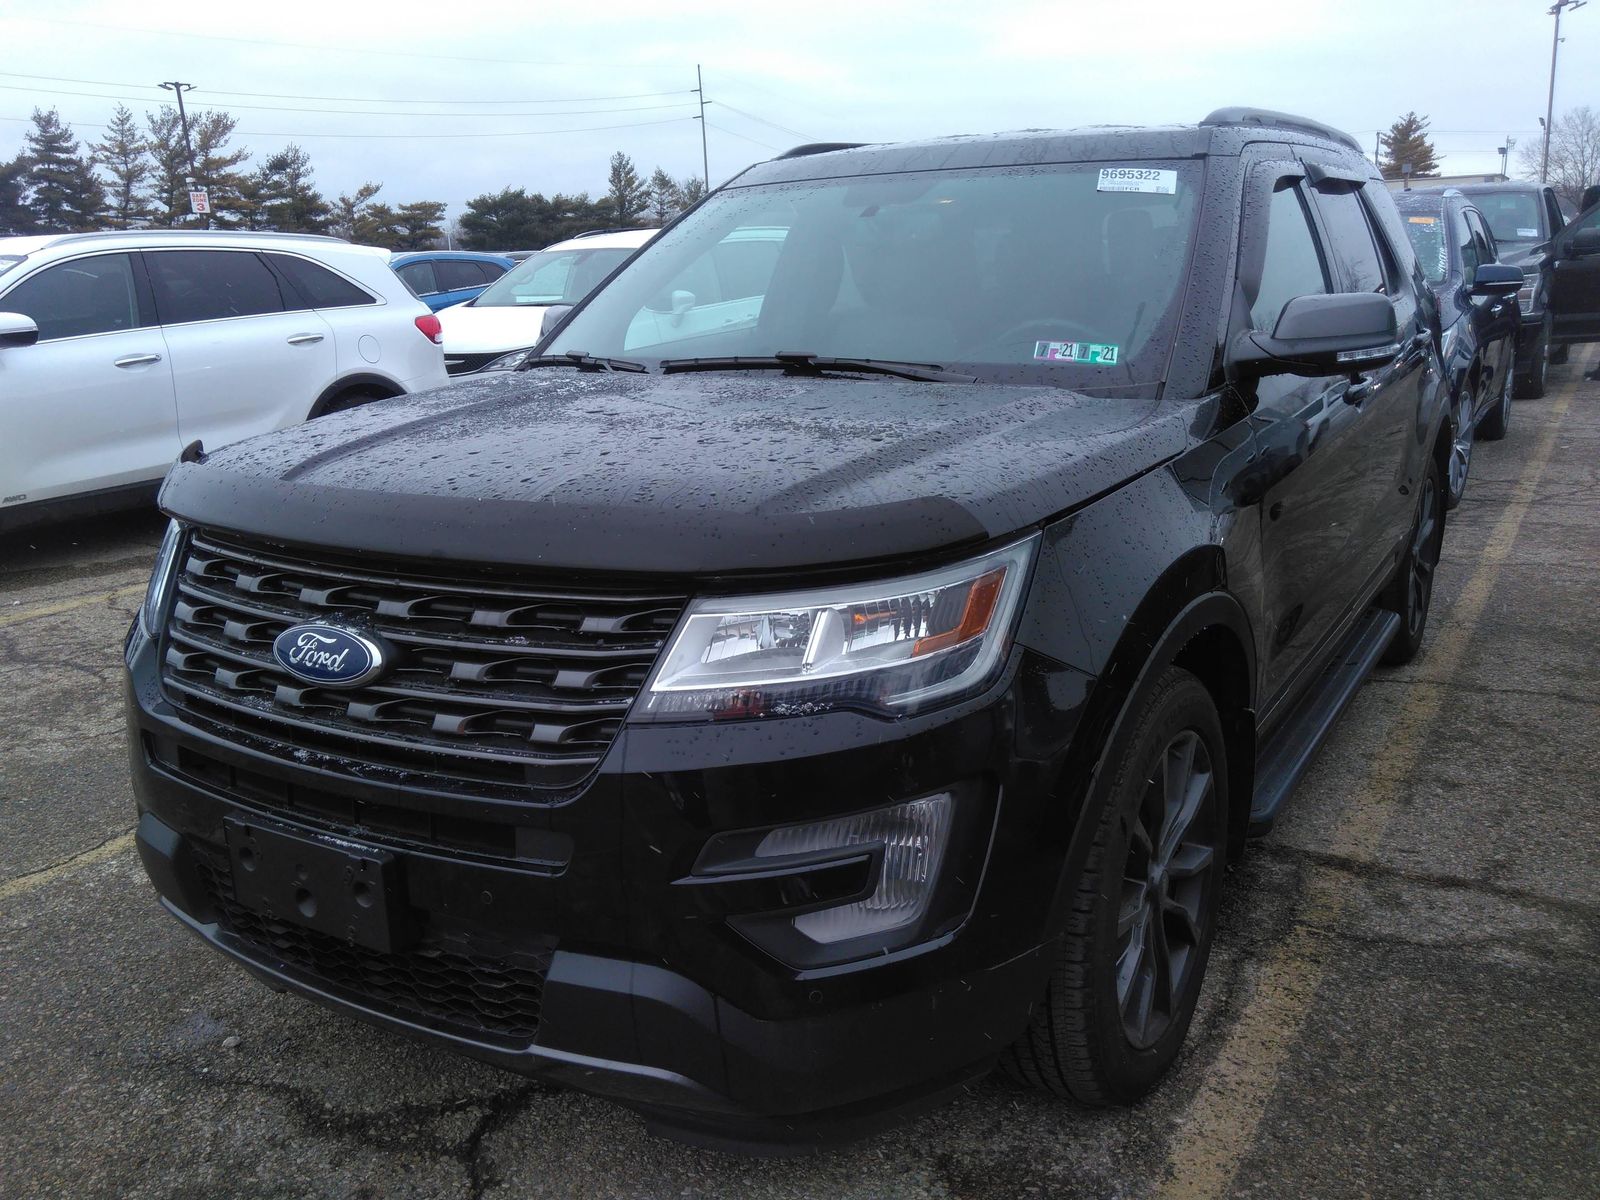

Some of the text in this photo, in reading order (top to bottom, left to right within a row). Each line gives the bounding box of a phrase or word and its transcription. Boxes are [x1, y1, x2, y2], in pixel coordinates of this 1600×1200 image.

[1101, 169, 1160, 181] 9695322
[197, 203, 205, 211] 3
[1061, 343, 1073, 357] 21
[1102, 346, 1115, 361] 21
[2, 494, 27, 504] AWD
[289, 632, 350, 672] Ford
